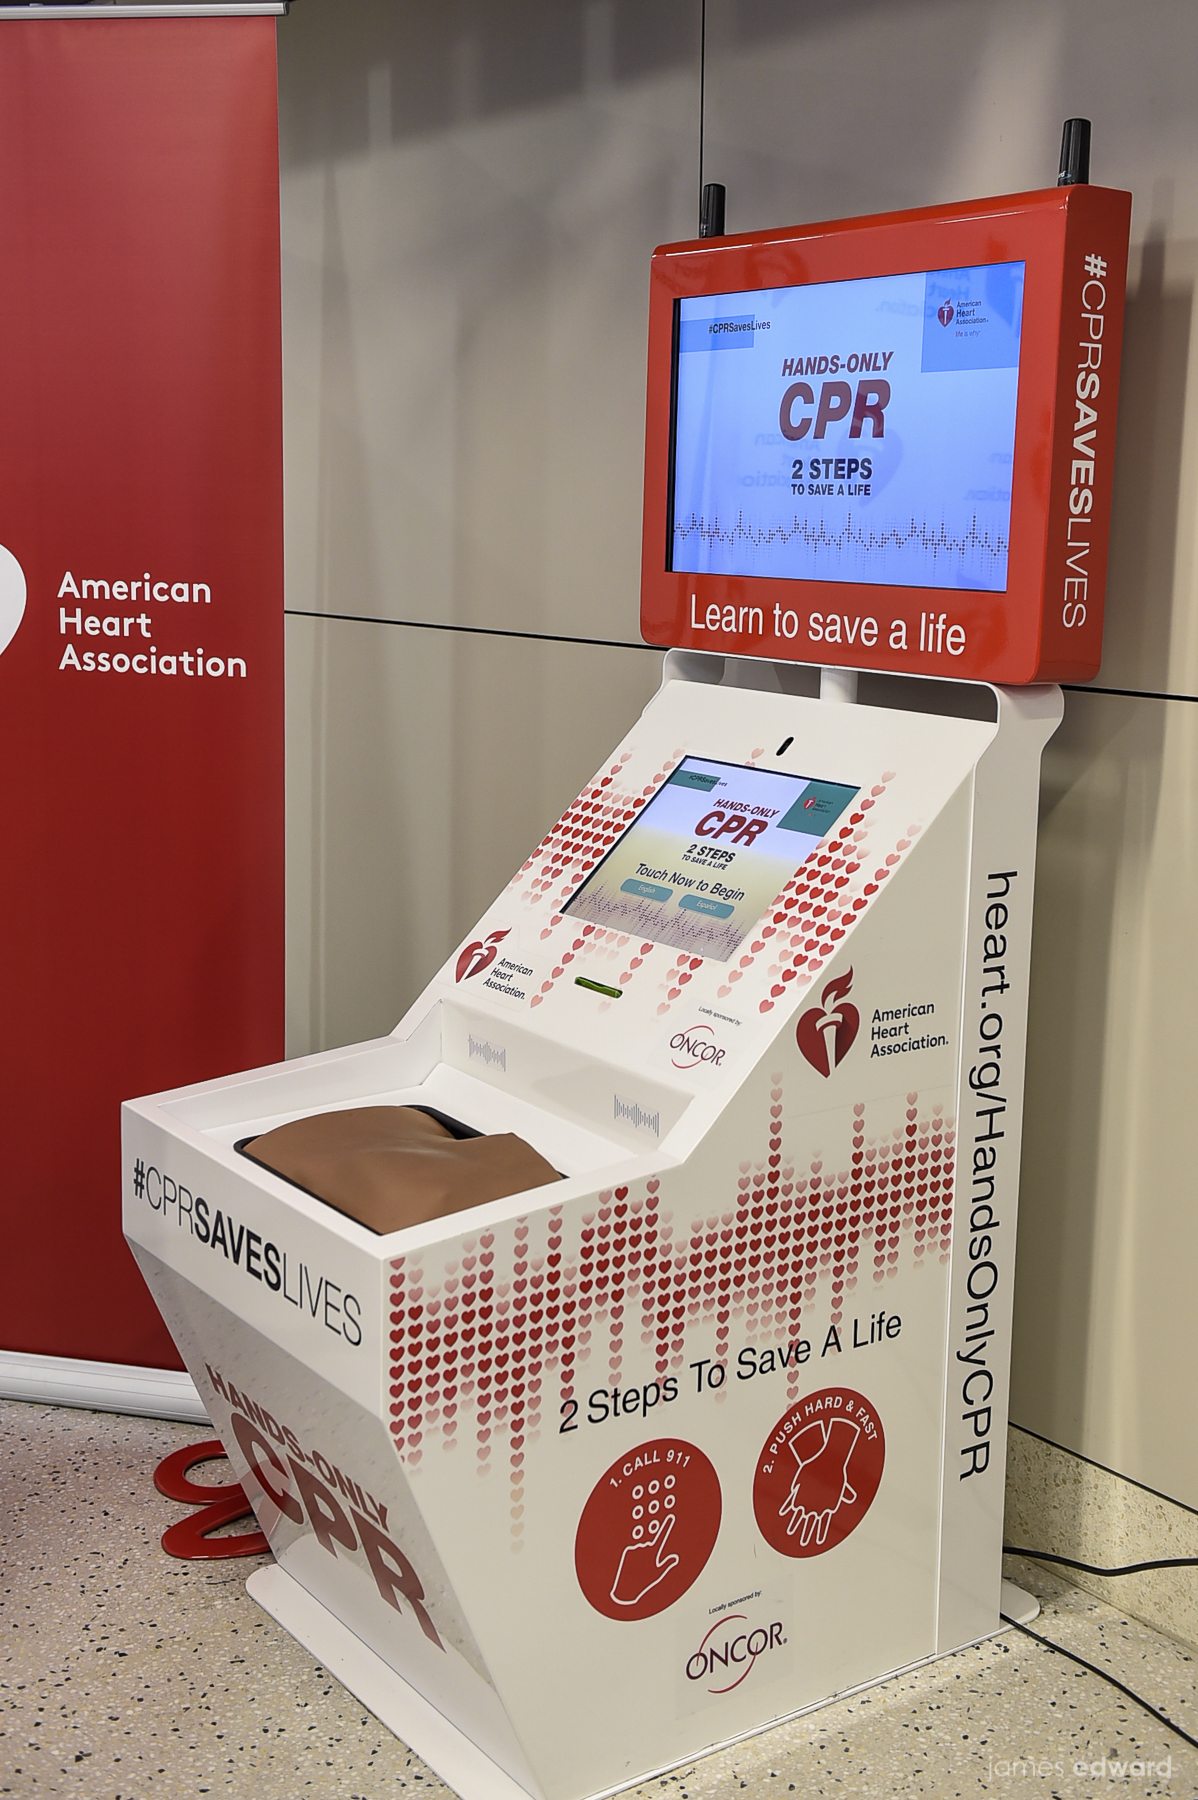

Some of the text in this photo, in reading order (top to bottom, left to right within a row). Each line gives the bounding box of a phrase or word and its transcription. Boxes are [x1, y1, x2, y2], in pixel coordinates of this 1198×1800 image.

[956, 300, 982, 308] American
[956, 308, 975, 318] Heart
[708, 320, 771, 335] #CPRSavesLives
[781, 351, 894, 377] HANDS-ONLY
[779, 378, 892, 441] CPR
[1062, 253, 1107, 628] #CPRSAVESLIVES
[791, 459, 803, 480] 2
[808, 457, 873, 480] STEPS
[791, 483, 871, 496] TO SAVE A LIFE
[57, 571, 211, 603] American
[59, 607, 152, 637] Heart
[691, 593, 966, 655] Learn to save a life
[58, 643, 247, 678] Association
[713, 798, 780, 818] HANDS-ONLY
[694, 810, 768, 847] CPR
[685, 844, 736, 863] 2 STEPS
[690, 856, 707, 866] SAVE
[713, 861, 728, 871] LIFE
[635, 863, 745, 901] Touch Now to Begin
[637, 884, 656, 895] English
[490, 967, 514, 982] Heart
[497, 957, 534, 977] American
[871, 1002, 935, 1024] American
[870, 1022, 910, 1041] Heart
[957, 870, 1019, 1483] heart.org/HandsOnlyCPR
[133, 1157, 363, 1347] #CPRSAVESLIVES
[558, 1311, 903, 1434] 2 Steps To Save A Life
[204, 1362, 390, 1532] HANDS-ONLY
[762, 1396, 878, 1474] 2. PUSH HARD & FAST
[609, 1449, 691, 1488] 1. CALL 911
[231, 1412, 446, 1655] CPR
[708, 1603, 727, 1614] Locally
[727, 1592, 754, 1607] sponsored
